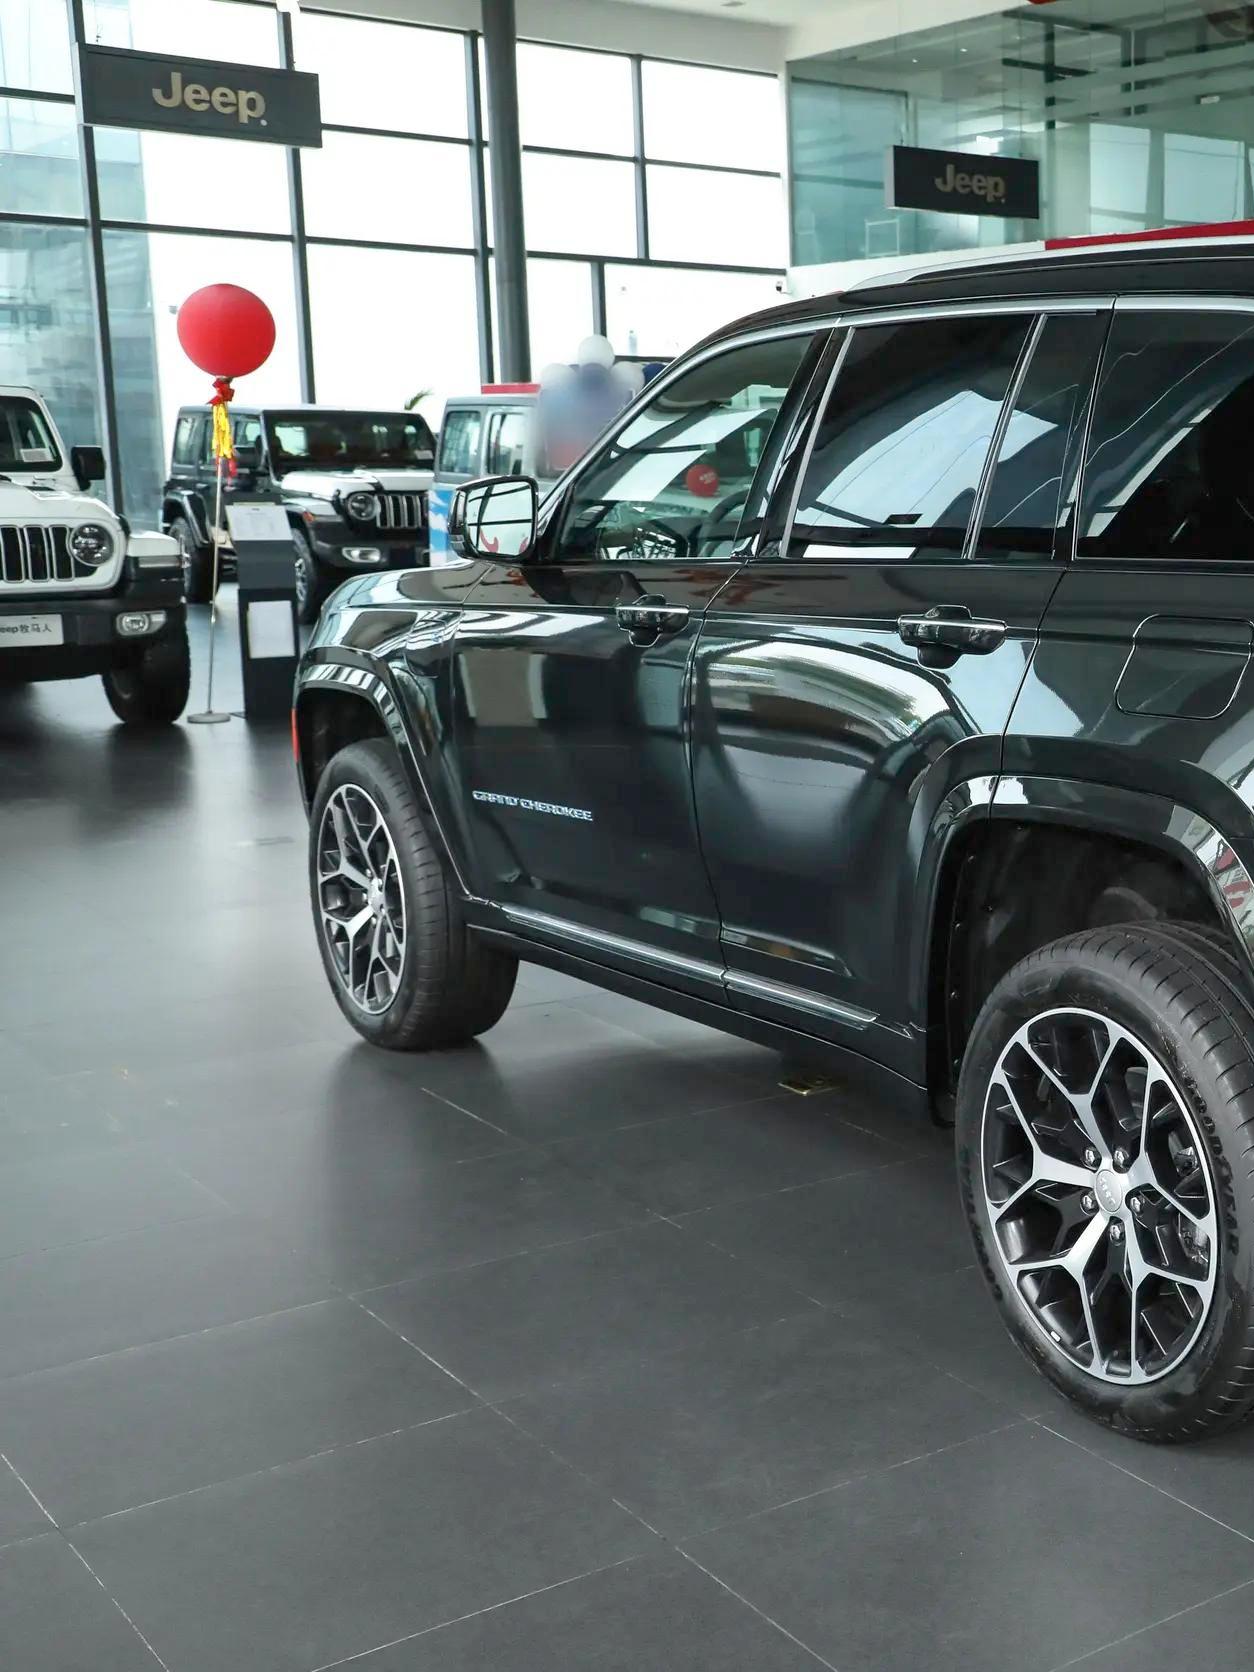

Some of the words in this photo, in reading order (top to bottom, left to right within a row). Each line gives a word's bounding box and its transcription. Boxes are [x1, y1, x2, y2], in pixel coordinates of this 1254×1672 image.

[152, 72, 266, 124] Jeep
[935, 164, 1006, 203] Jeep
[472, 790, 519, 806] GRAND
[520, 798, 594, 821] CHEROKEE
